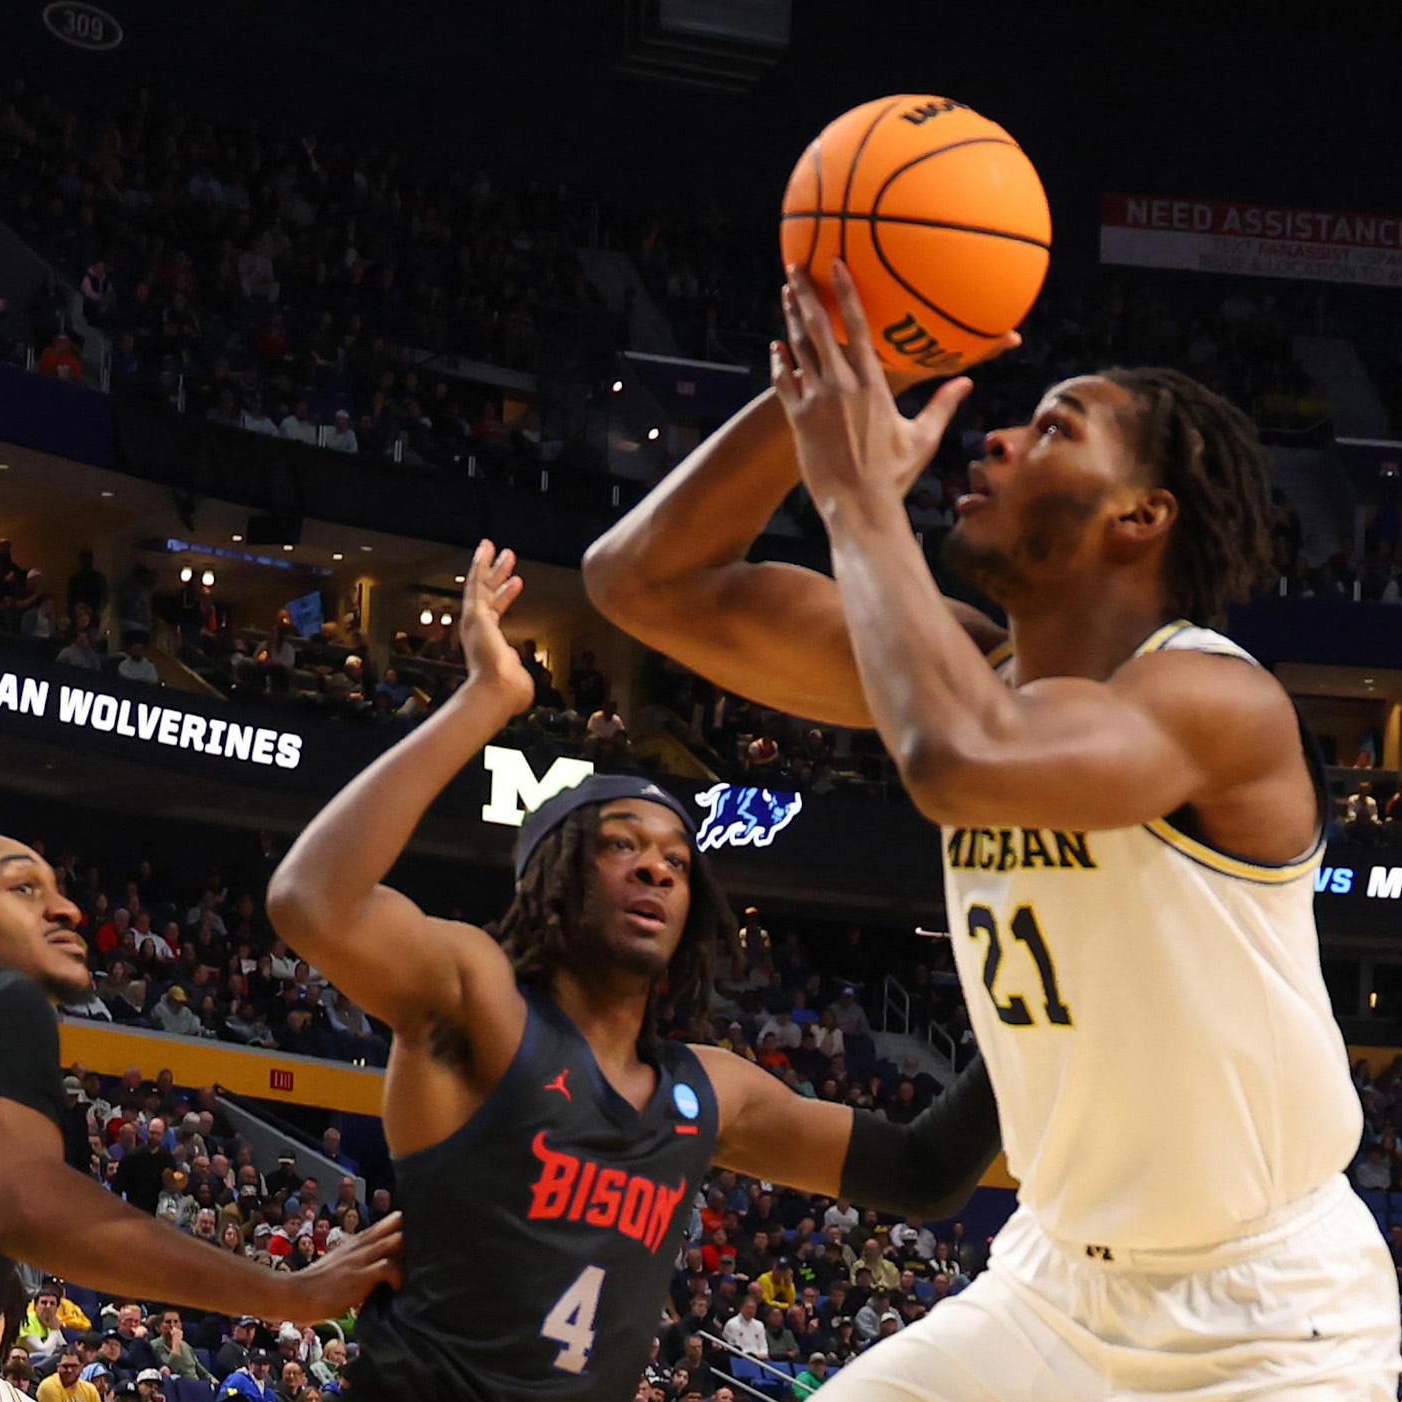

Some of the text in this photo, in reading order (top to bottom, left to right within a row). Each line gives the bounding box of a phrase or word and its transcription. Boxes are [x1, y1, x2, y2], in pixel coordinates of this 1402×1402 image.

[62, 9, 104, 42] 309
[1125, 198, 1213, 231] NEED
[58, 685, 303, 770] WOLVERINES
[967, 904, 1073, 1027] 21
[527, 1131, 686, 1254] BISON
[540, 1264, 607, 1375] 4
